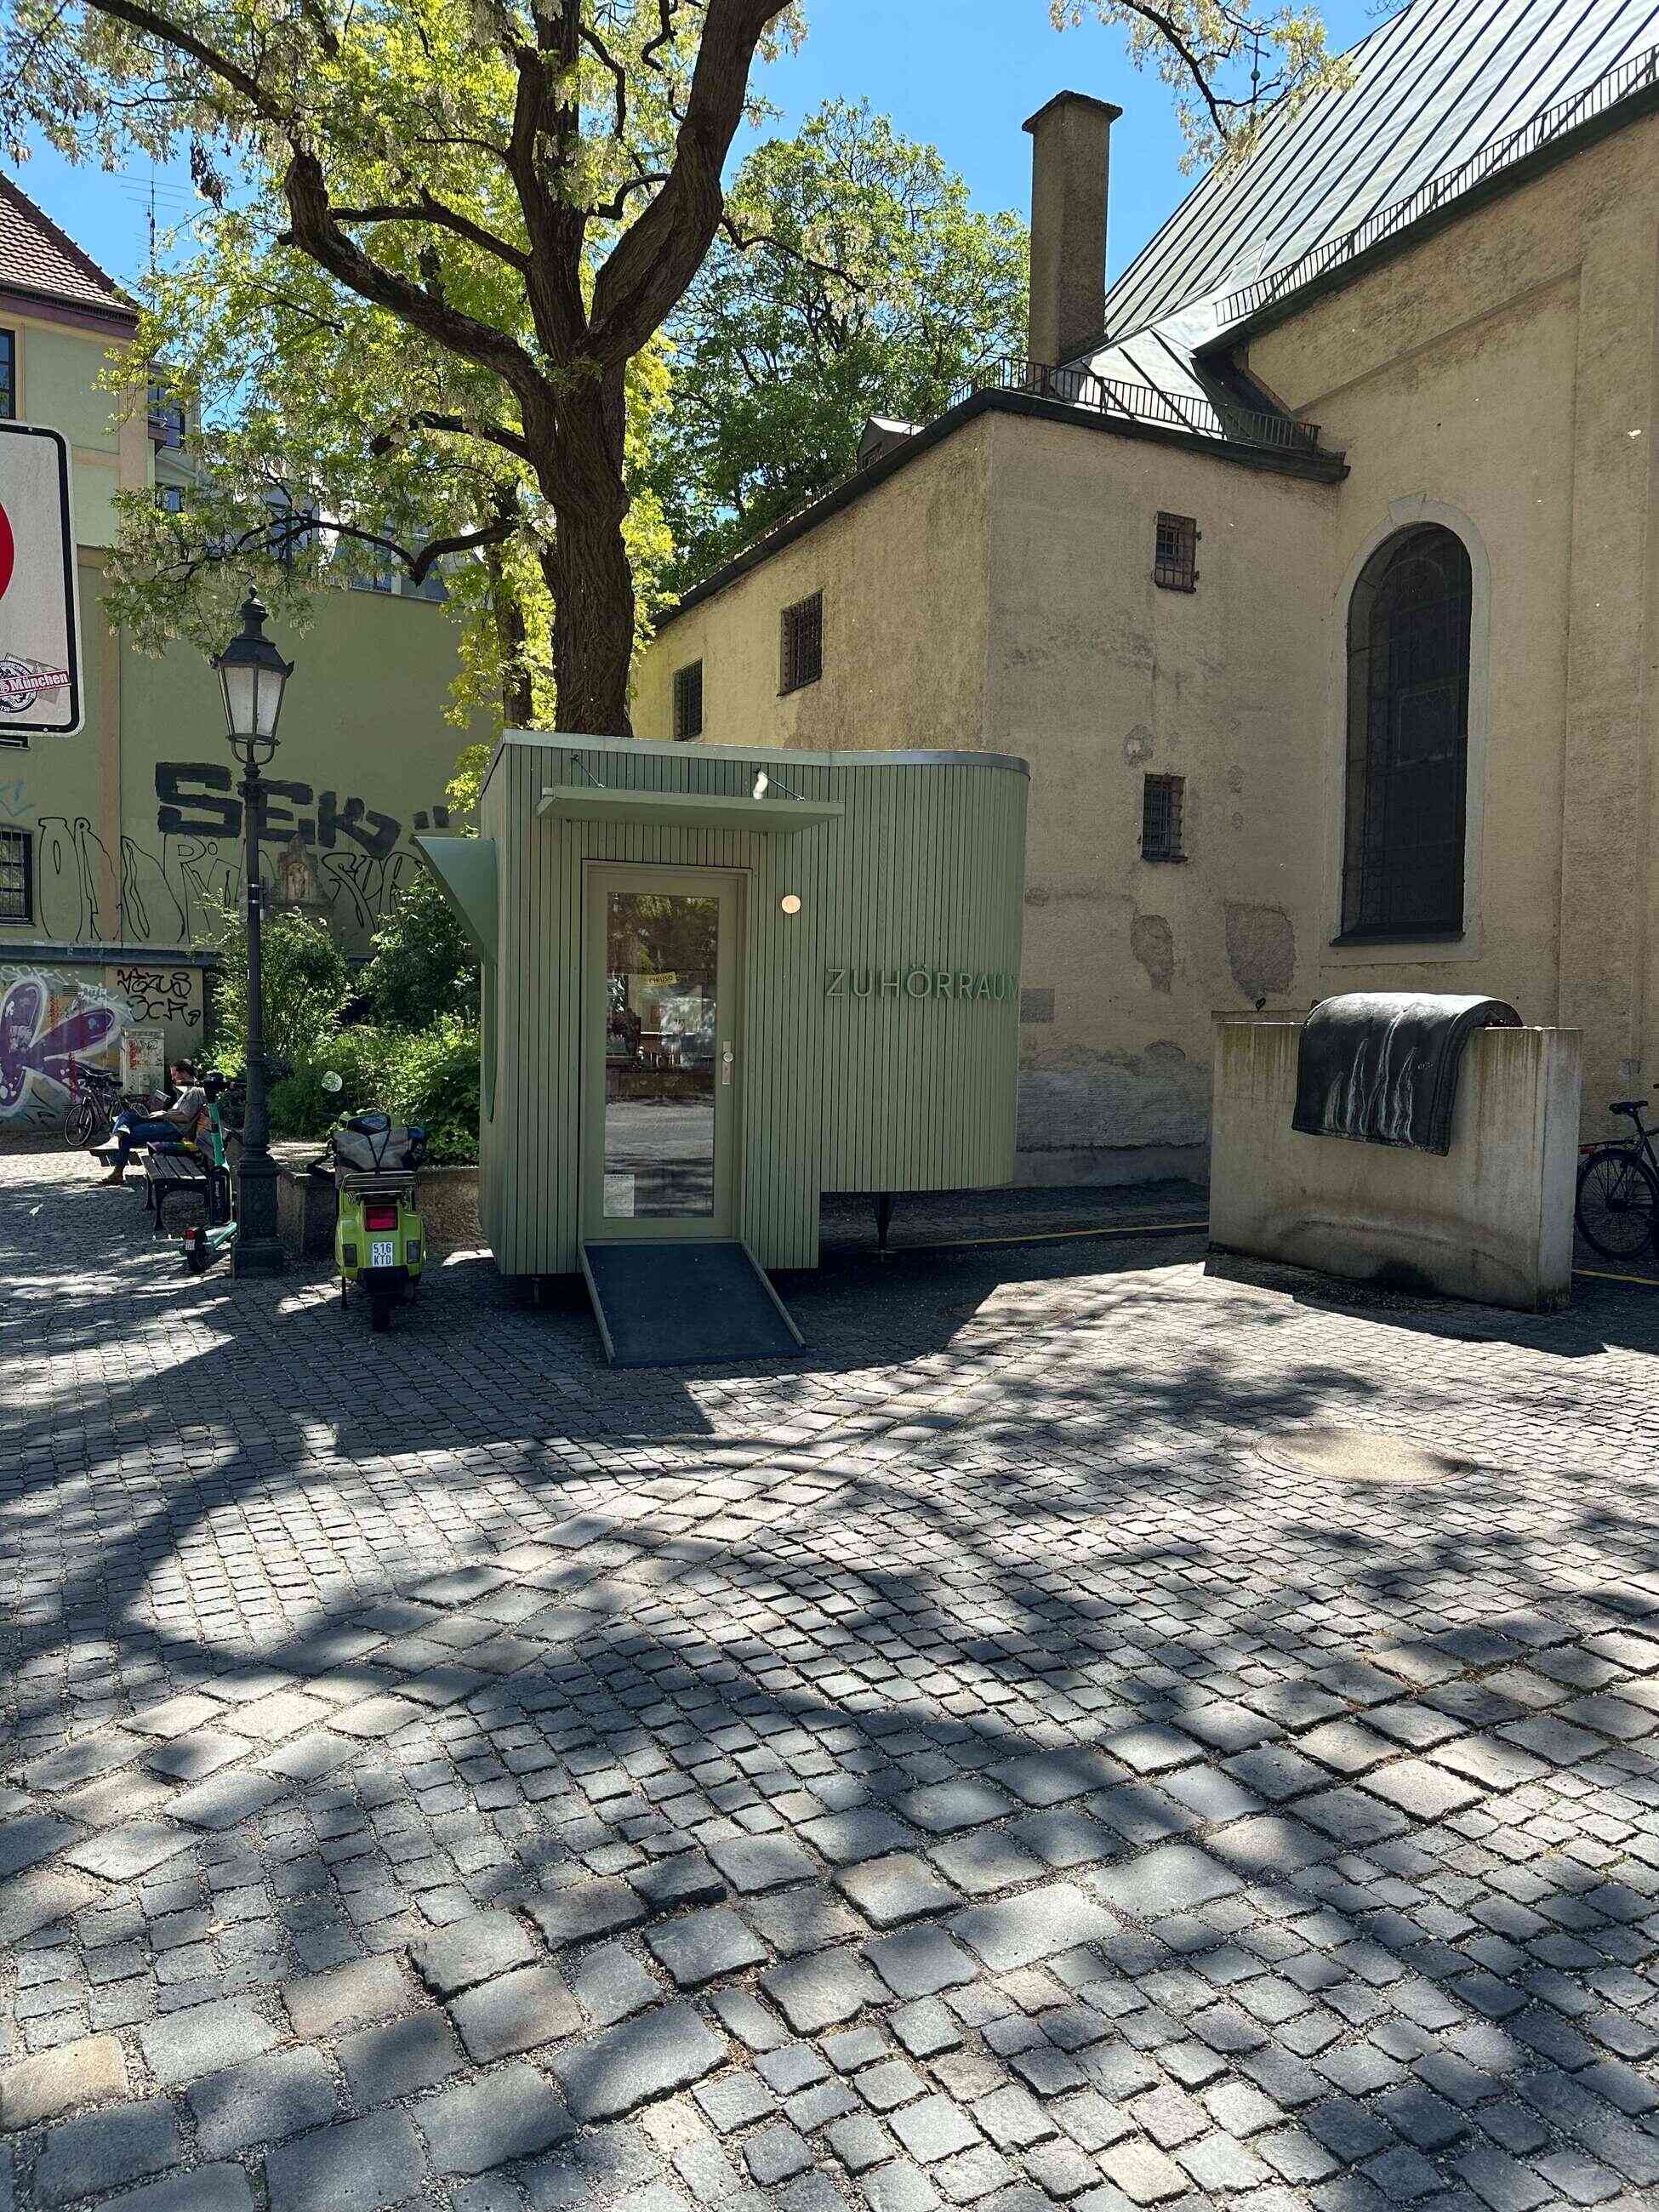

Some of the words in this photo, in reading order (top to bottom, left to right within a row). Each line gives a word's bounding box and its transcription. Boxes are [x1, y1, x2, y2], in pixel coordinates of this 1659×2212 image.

[9, 672, 68, 691] München
[373, 1243, 391, 1254] 516
[373, 1254, 391, 1266] KTD
